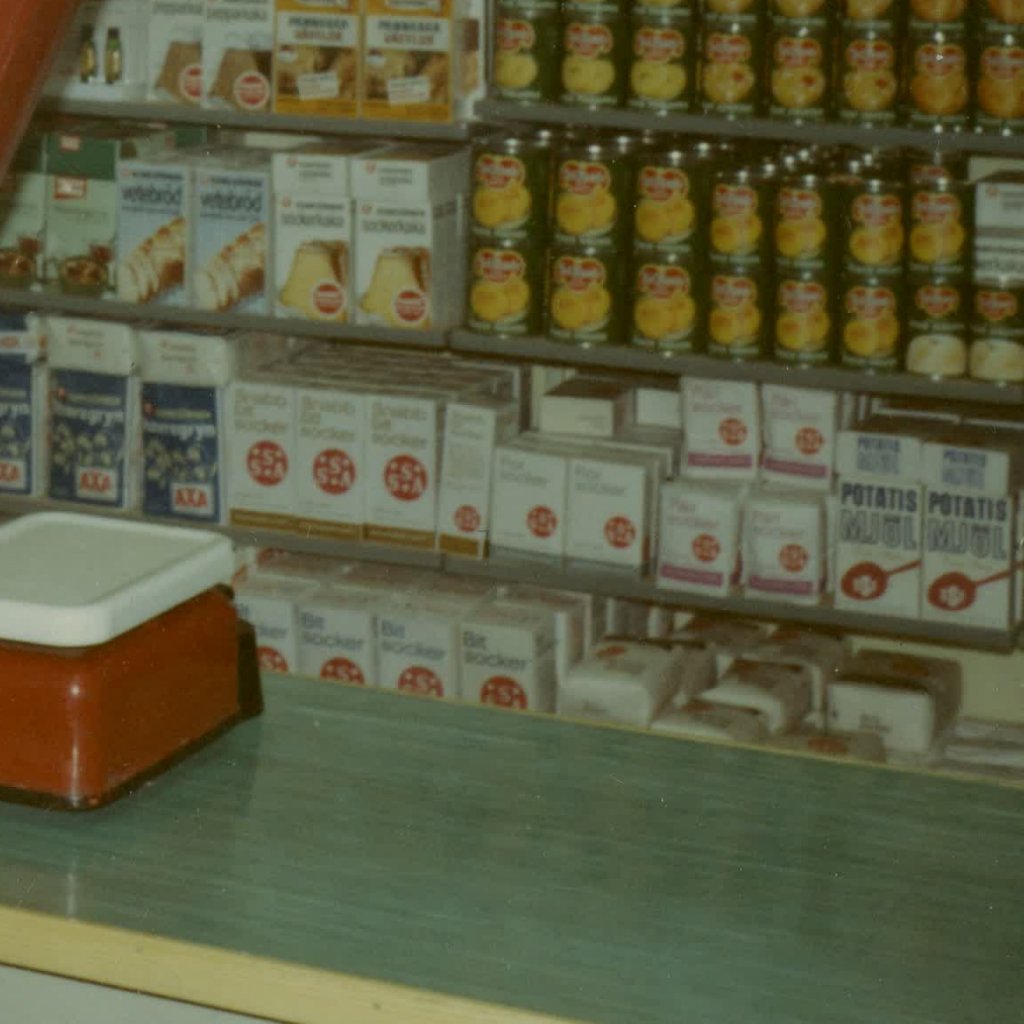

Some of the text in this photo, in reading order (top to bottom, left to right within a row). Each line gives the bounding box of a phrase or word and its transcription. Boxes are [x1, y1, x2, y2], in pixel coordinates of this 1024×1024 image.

[80, 472, 111, 492] AXA
[175, 488, 207, 508] AXA
[841, 481, 918, 514] POTATIS
[928, 491, 1008, 523] POTATIS
[301, 631, 364, 652] socker
[381, 640, 447, 661] socker
[463, 630, 488, 650] Bit
[463, 651, 533, 672] socker
